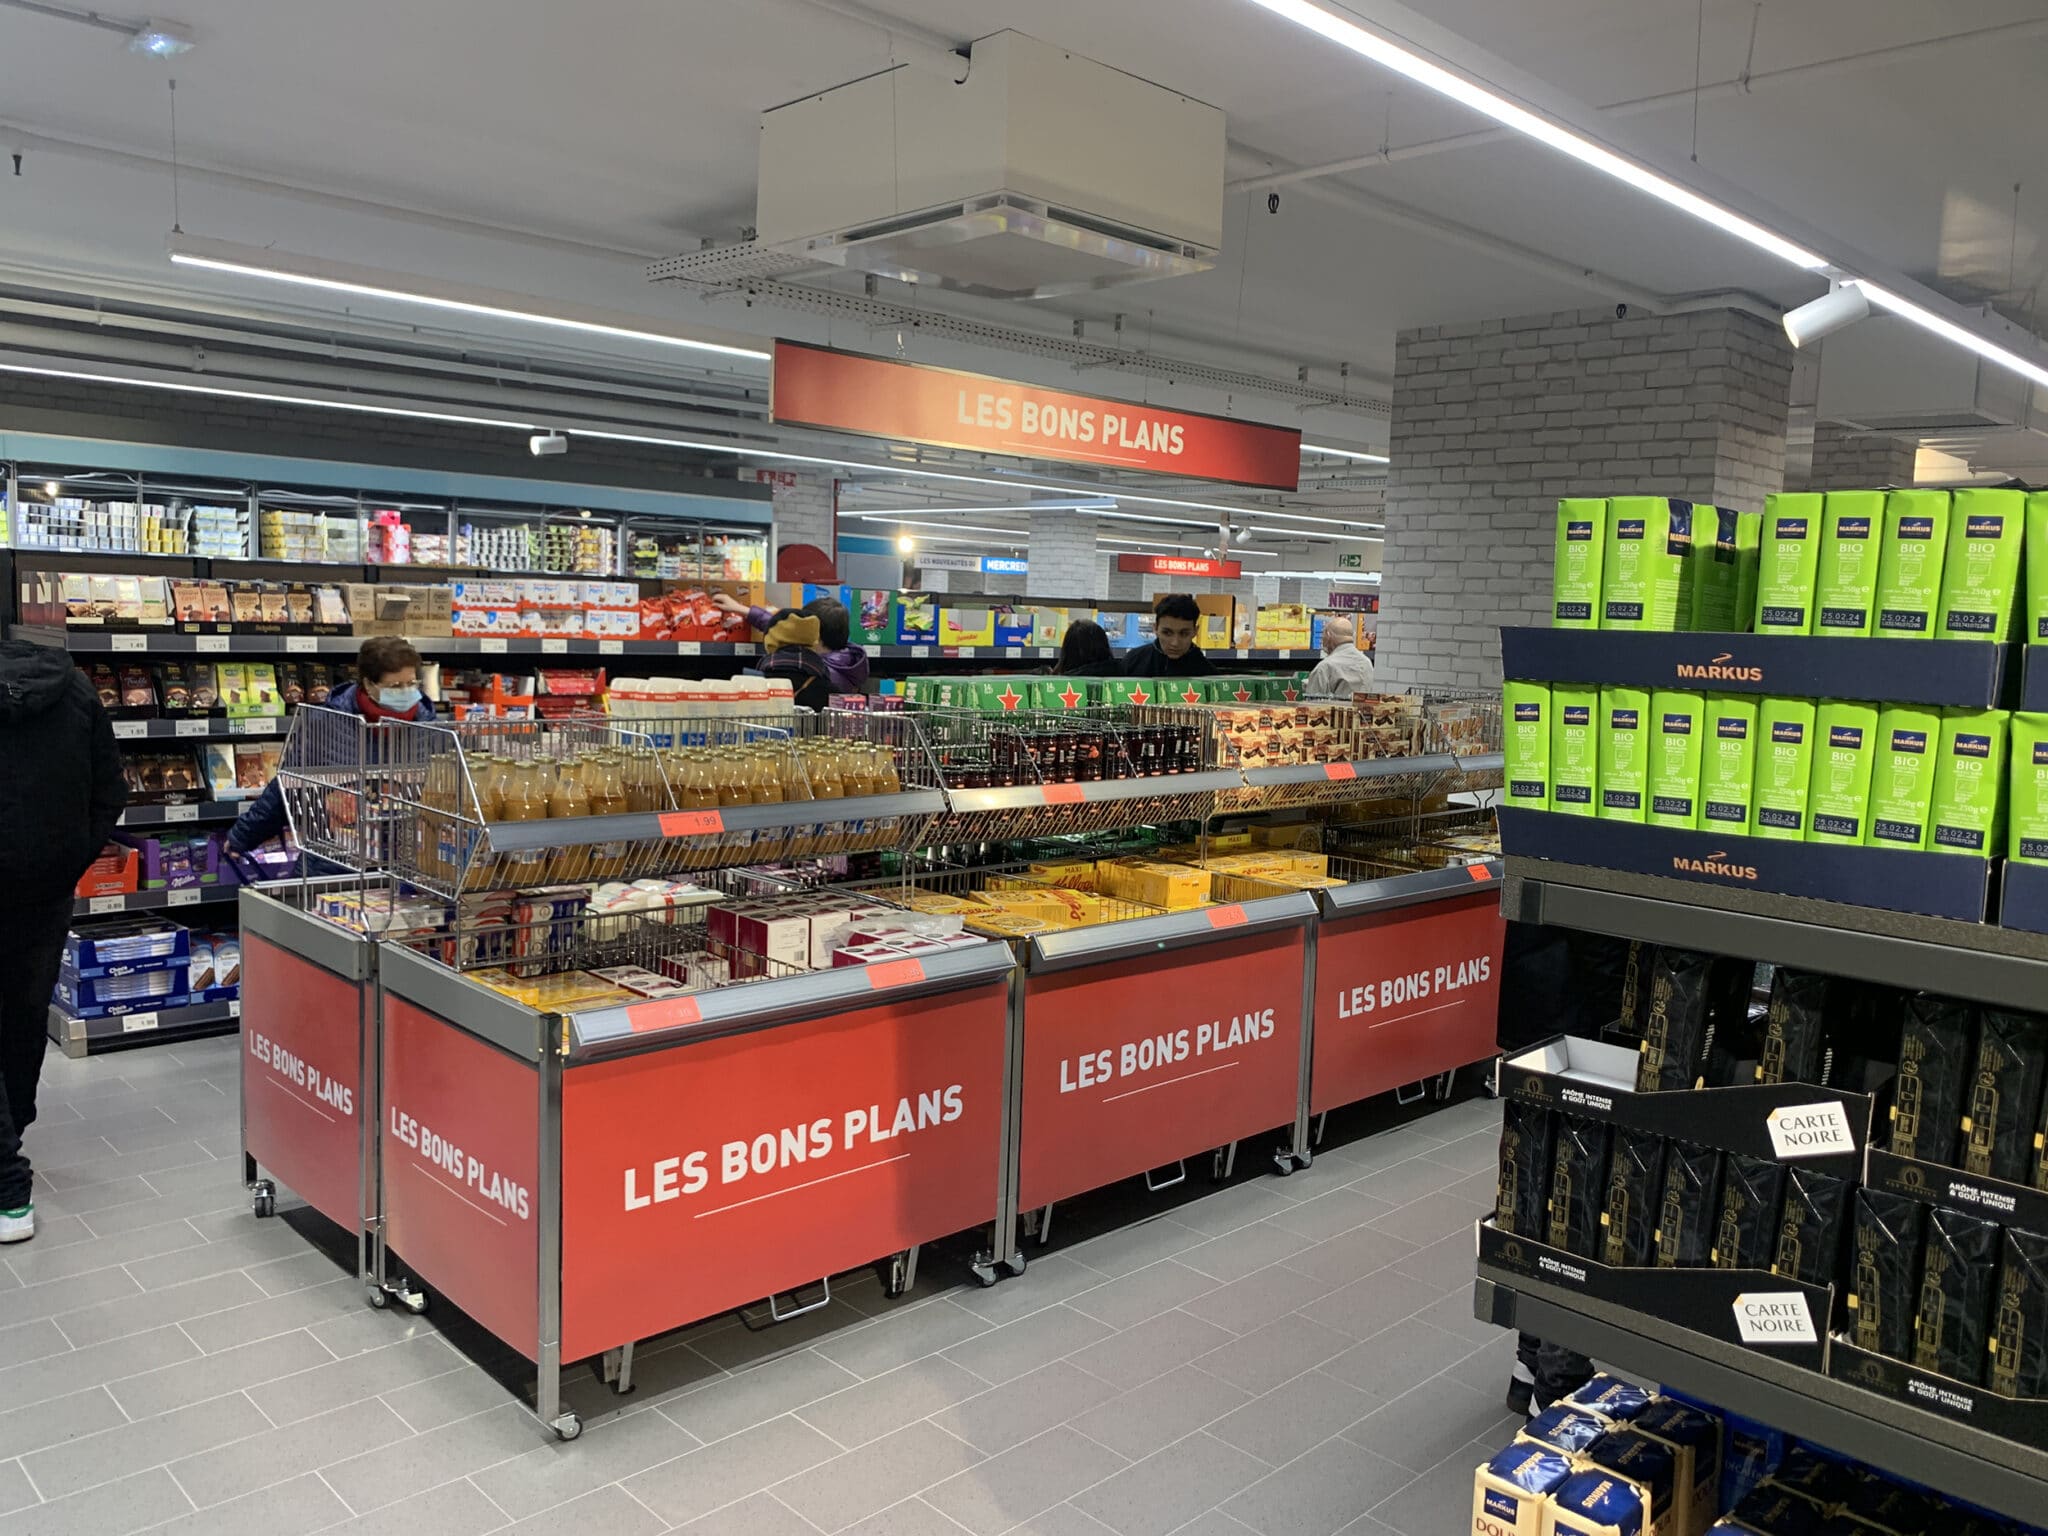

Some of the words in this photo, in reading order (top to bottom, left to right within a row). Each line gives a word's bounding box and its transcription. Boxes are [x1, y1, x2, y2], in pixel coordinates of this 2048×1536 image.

[958, 391, 1011, 429] LES
[1021, 402, 1095, 442] BONS
[1102, 414, 1184, 455] PLANS
[1568, 545, 1587, 553] BIO
[1619, 544, 1639, 552] BIO
[1778, 544, 1801, 553] BIO
[1839, 543, 1863, 553] BIO
[1900, 543, 1925, 553] BIO
[1968, 543, 1995, 553] BIO
[987, 560, 1028, 572] MERCRED
[1154, 560, 1167, 569] LES
[1168, 561, 1186, 570] BONS
[1188, 562, 1209, 572] PLANS
[1608, 604, 1638, 612] 25.02.24
[1763, 609, 1798, 618] 25.02.24
[1822, 612, 1859, 621] 25.02.24
[1882, 614, 1921, 623] 25.02.24
[1948, 614, 1990, 623] 25.02.24
[1677, 664, 1763, 682] MARKUS
[1518, 726, 1536, 735] BIO
[1566, 729, 1585, 738] BIO
[1614, 733, 1634, 742] BIO
[1666, 738, 1686, 747] BIO
[1720, 742, 1742, 752] BIO
[1774, 747, 1797, 757] BIO
[1832, 752, 1855, 762] BIO
[1894, 756, 1919, 767] BIO
[1956, 760, 1982, 772] BIO
[2037, 769, 2048, 780] BI
[1511, 784, 1540, 793] 25.02.24
[1558, 788, 1586, 796] 25.02.24
[1605, 794, 1635, 803] 25.02.24
[1654, 800, 1686, 809] 25.02.24
[1707, 804, 1740, 814] 25.02.24
[695, 816, 717, 826] 1.99
[1761, 811, 1795, 822] 25.02.24
[1815, 817, 1852, 829] 25.02.24
[1876, 822, 1915, 834] 25.02.24
[1937, 828, 1977, 840] 25.02.24
[2022, 843, 2048, 853] 25.02
[1673, 856, 1758, 880] MARKUS
[171, 875, 196, 887] Milka
[1339, 984, 1375, 1019] LES
[1381, 969, 1430, 1008] BONS
[1435, 956, 1490, 994] PLANS
[1061, 1050, 1112, 1094] LES
[1120, 1029, 1189, 1077] BONS
[1196, 1008, 1275, 1056] PLANS
[249, 1029, 271, 1064] LES
[272, 1045, 305, 1087] BONS
[307, 1065, 353, 1115] PLANS
[1561, 1088, 1584, 1098] ARÔME
[1585, 1091, 1612, 1104] INTENSE
[1587, 1100, 1611, 1110] UNIQUE
[1779, 1113, 1839, 1131] CARTE
[1784, 1128, 1844, 1147] NOIRE
[624, 1151, 709, 1212] LES
[722, 1118, 833, 1185] BONS
[844, 1084, 963, 1151] PLANS
[391, 1106, 418, 1149] LES
[421, 1126, 464, 1180] BONS
[467, 1156, 529, 1220] PLANS
[1948, 1182, 1979, 1195] ARÔME
[1980, 1190, 2016, 1205] INTENSE
[1982, 1198, 2015, 1212] UNIQUE
[1539, 1256, 1560, 1267] ARÔME
[1560, 1263, 1586, 1276] INTENSE
[1562, 1269, 1585, 1282] UNIQUE
[1745, 1303, 1801, 1317] CARTE
[1750, 1319, 1806, 1333] NOIRE
[1908, 1379, 1937, 1393] ARÔME
[1938, 1389, 1973, 1406] INTENSE
[1909, 1385, 1915, 1393] &
[1941, 1396, 1972, 1412] UNIQUE
[1582, 1480, 1613, 1508] MARKUS
[1487, 1498, 1515, 1516] MARKUS
